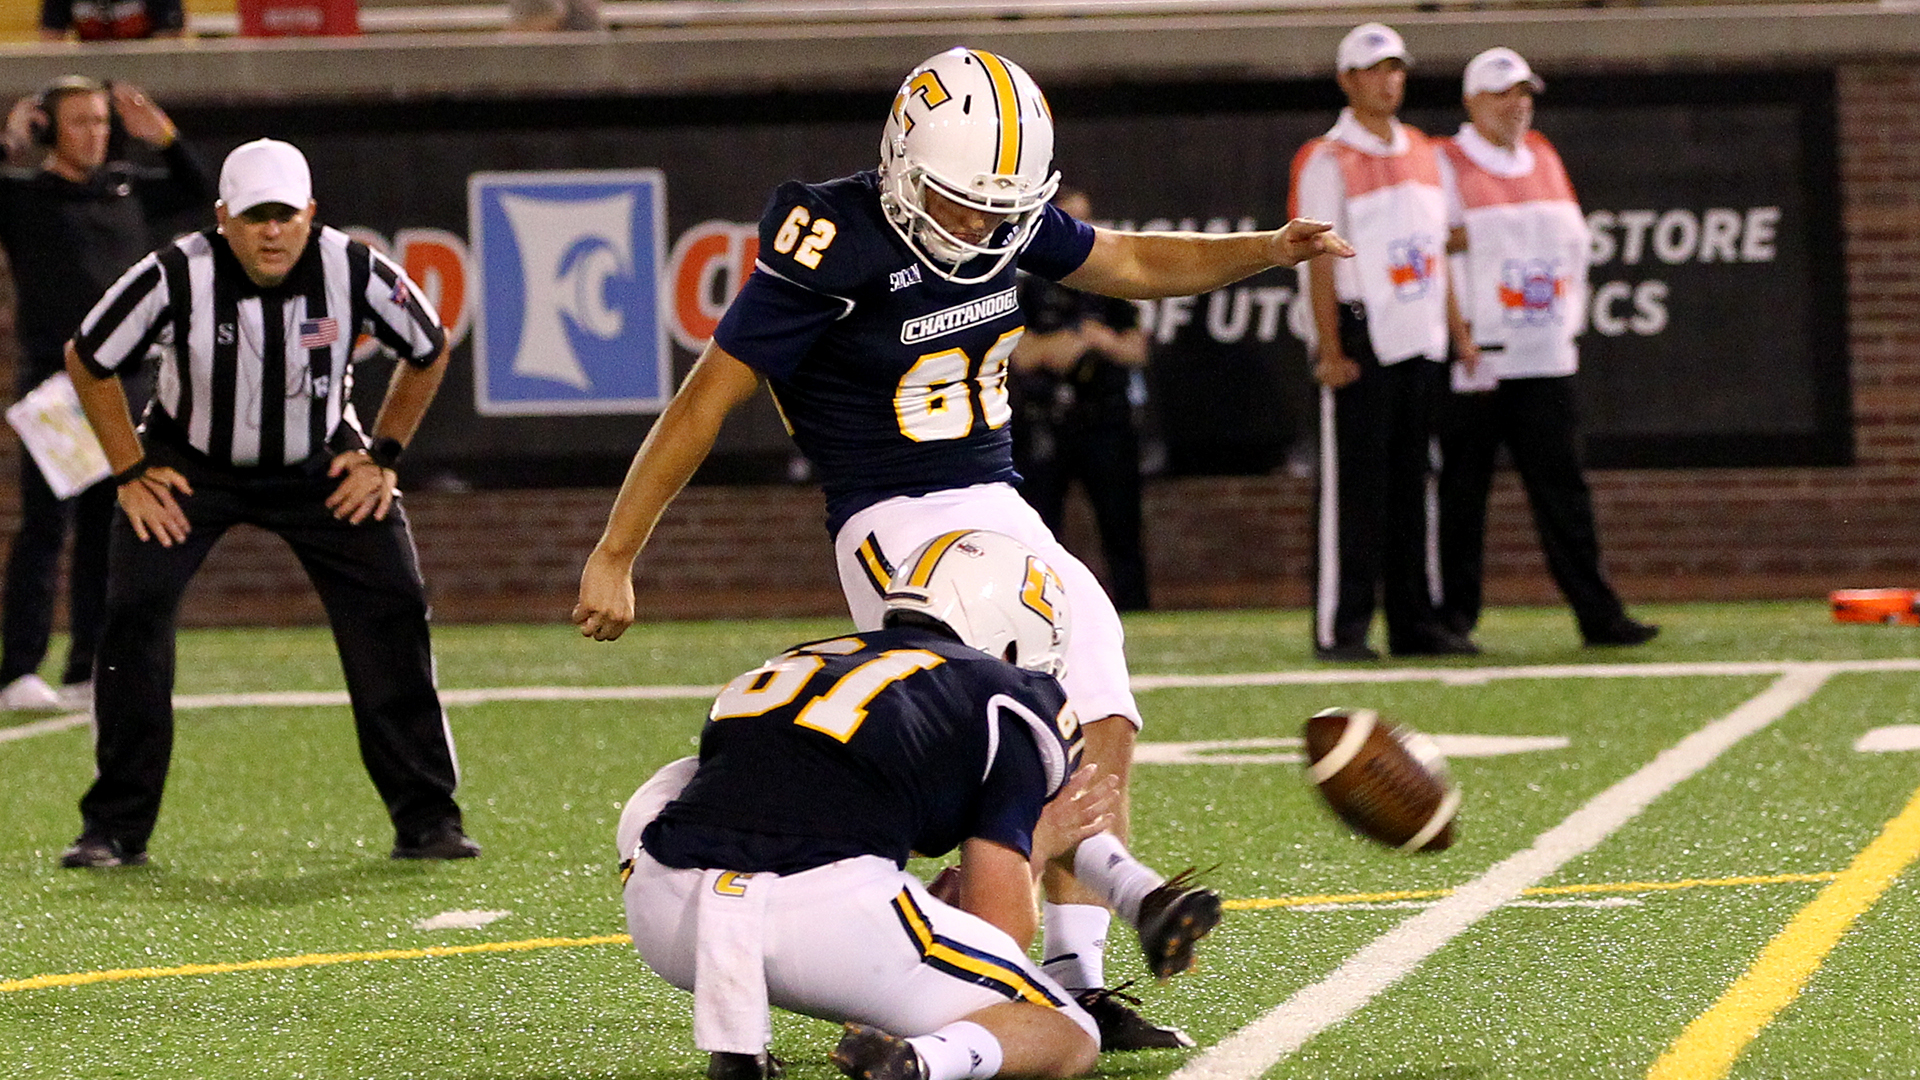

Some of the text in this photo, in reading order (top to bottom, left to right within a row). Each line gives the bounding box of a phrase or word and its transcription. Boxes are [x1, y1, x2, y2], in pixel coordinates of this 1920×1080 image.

[773, 205, 837, 270] 62
[1587, 207, 1783, 266] STORE
[709, 637, 948, 744] 61
